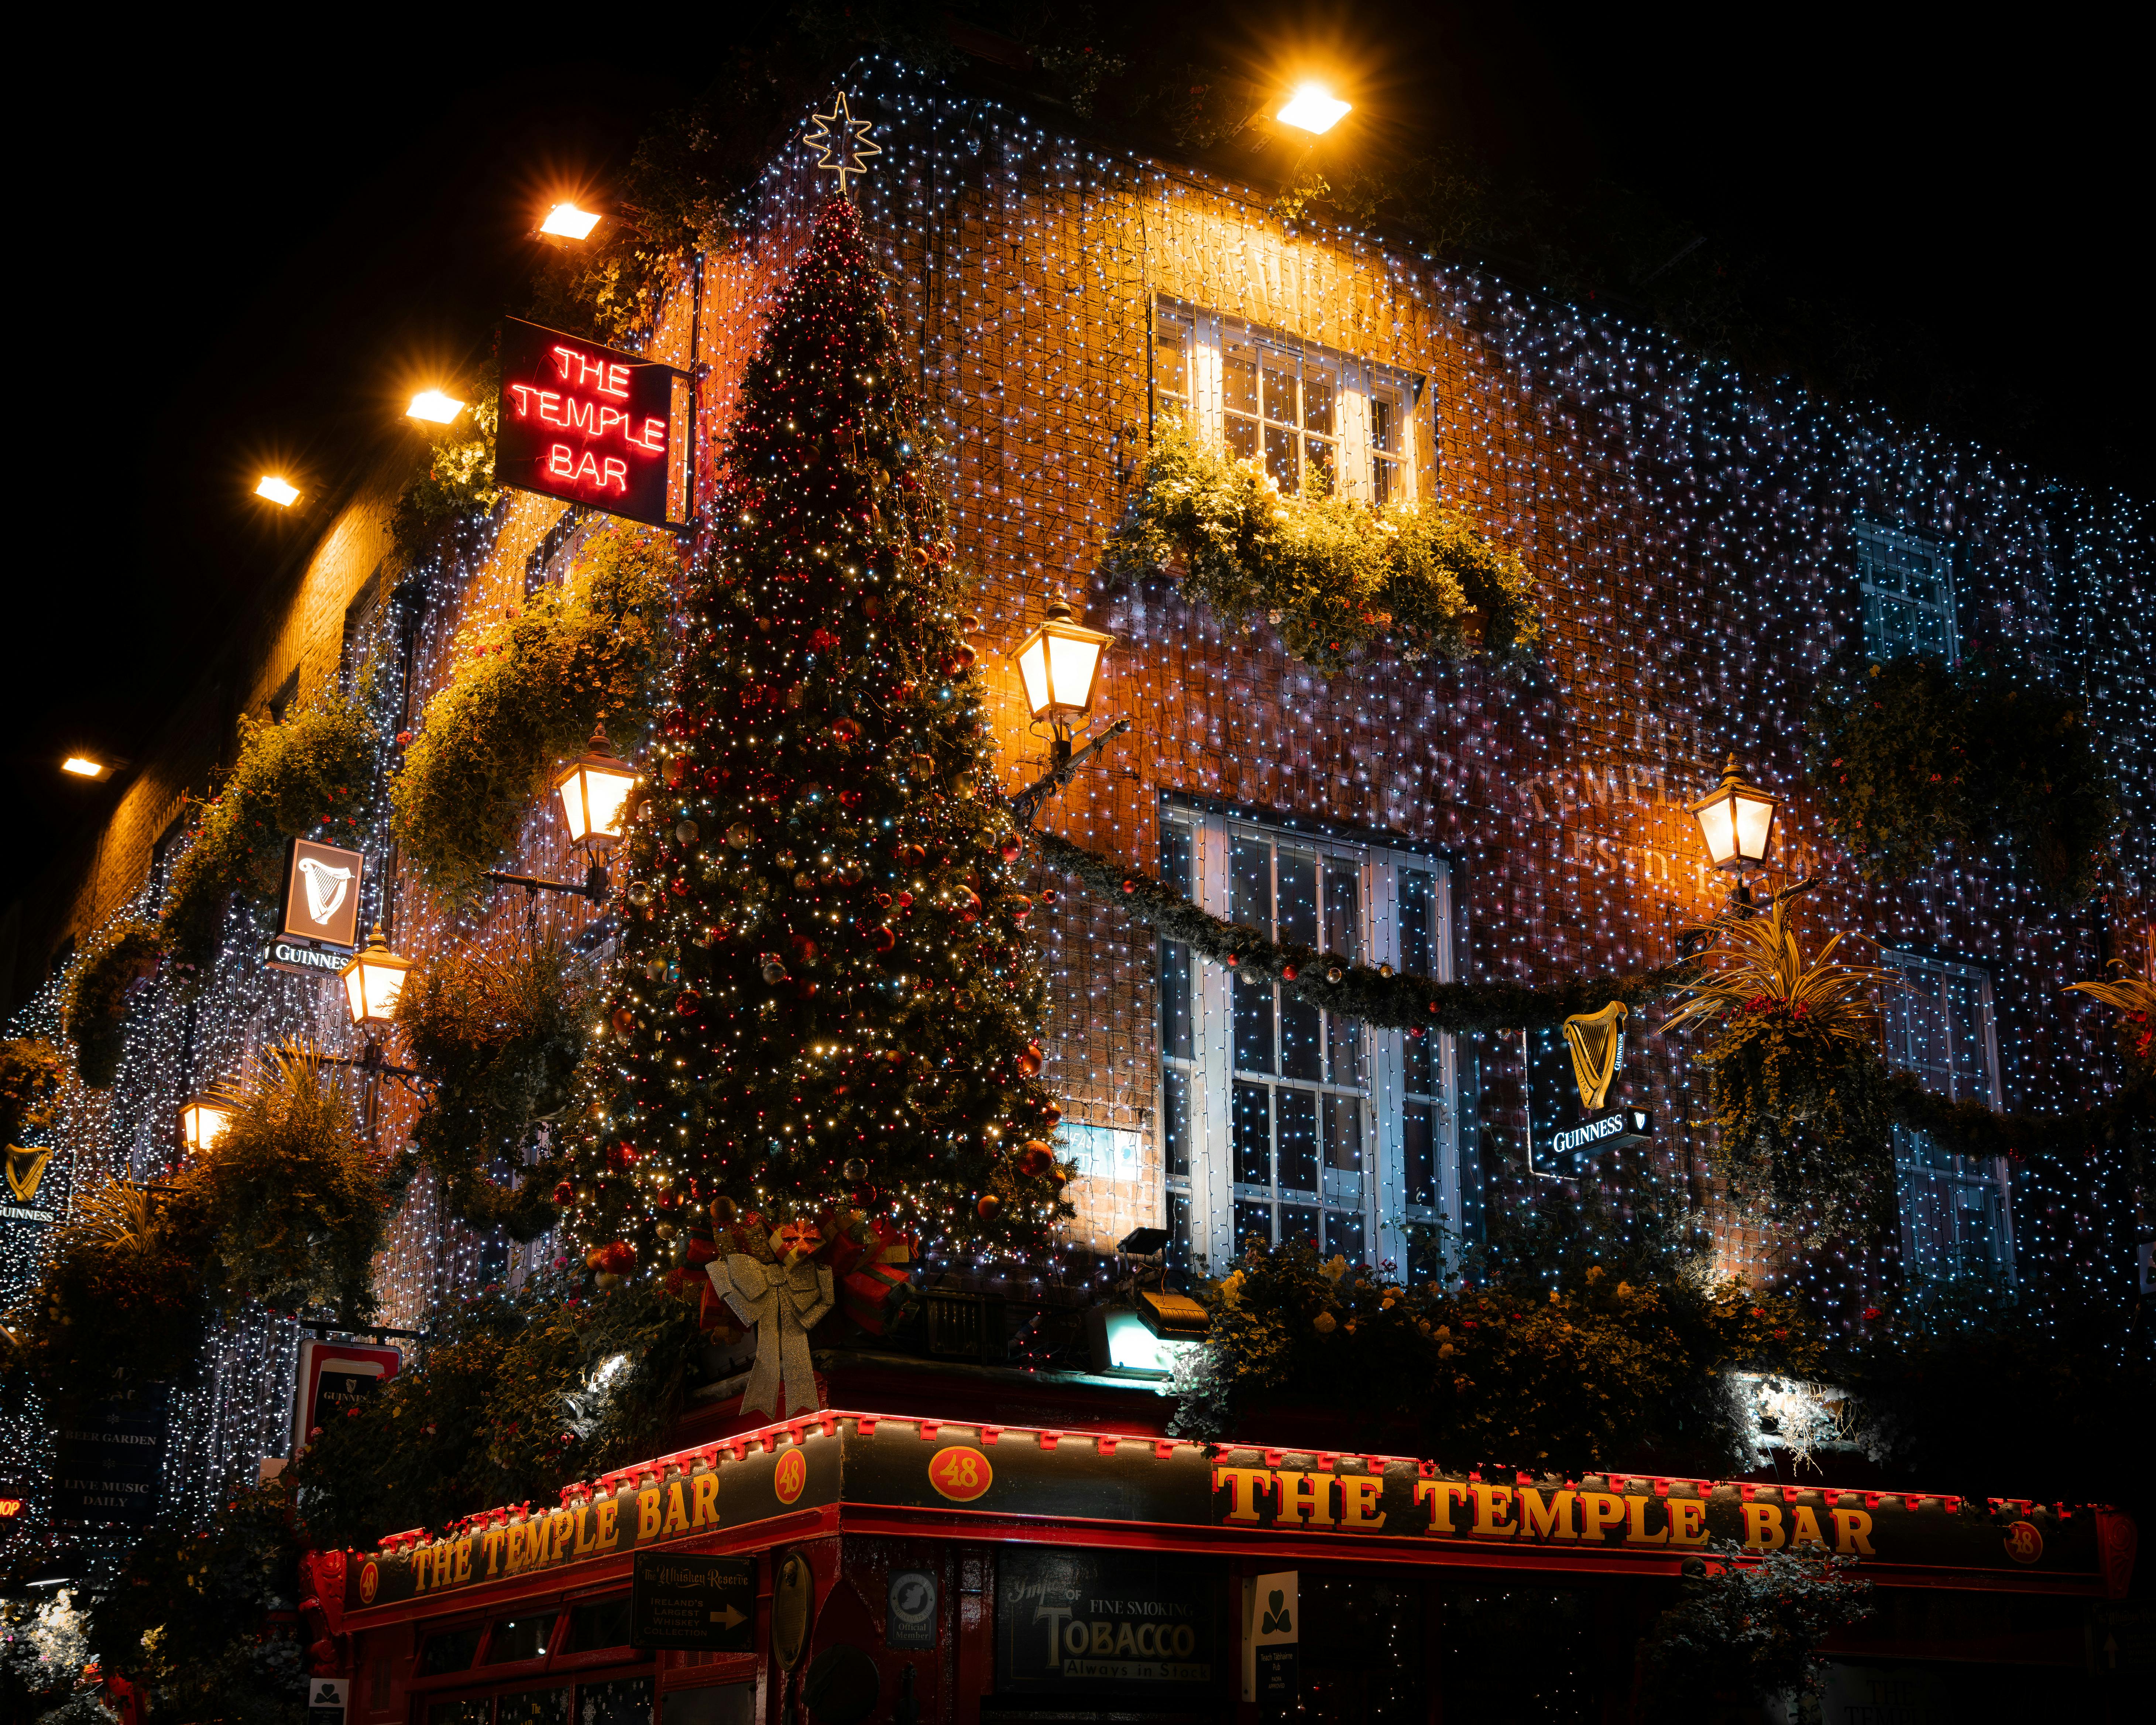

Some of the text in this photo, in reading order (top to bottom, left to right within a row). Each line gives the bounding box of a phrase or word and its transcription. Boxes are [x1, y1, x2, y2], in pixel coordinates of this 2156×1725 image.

[554, 346, 630, 398] THE
[512, 385, 665, 452] TEMPLE
[550, 444, 626, 491] BAR
[276, 944, 349, 970] GUINNES
[1614, 1033, 1623, 1071] GUINNESS
[1553, 1114, 1623, 1152] GUINNESS
[65, 1429, 157, 1445] BEER GARDEN
[780, 1460, 800, 1494] 48
[940, 1454, 978, 1488] 48
[64, 1479, 150, 1493] LIVE MUSIC
[83, 1495, 129, 1507] DAILY
[1217, 1467, 1876, 1555] THE TEMPLE BAR
[412, 1472, 720, 1591] THE TEMPLE BAR
[2009, 1528, 2033, 1554] 48
[363, 1571, 374, 1598] 48
[643, 1564, 750, 1590] The Whiskey Reserve
[650, 1597, 704, 1607] IRELAND'S
[1066, 1589, 1082, 1601] OF
[654, 1607, 700, 1617] LARGEST
[1089, 1599, 1194, 1616] FINE SMOKING
[643, 1627, 708, 1637] COLLECTION
[653, 1617, 700, 1627] WHISKEY
[898, 1623, 926, 1631] Official
[895, 1631, 929, 1640] Member
[1033, 1606, 1195, 1669] TOBACCO
[1067, 1660, 1208, 1678] Always in Stock
[1273, 1663, 1281, 1671] Pub
[532, 1703, 542, 1714] The
